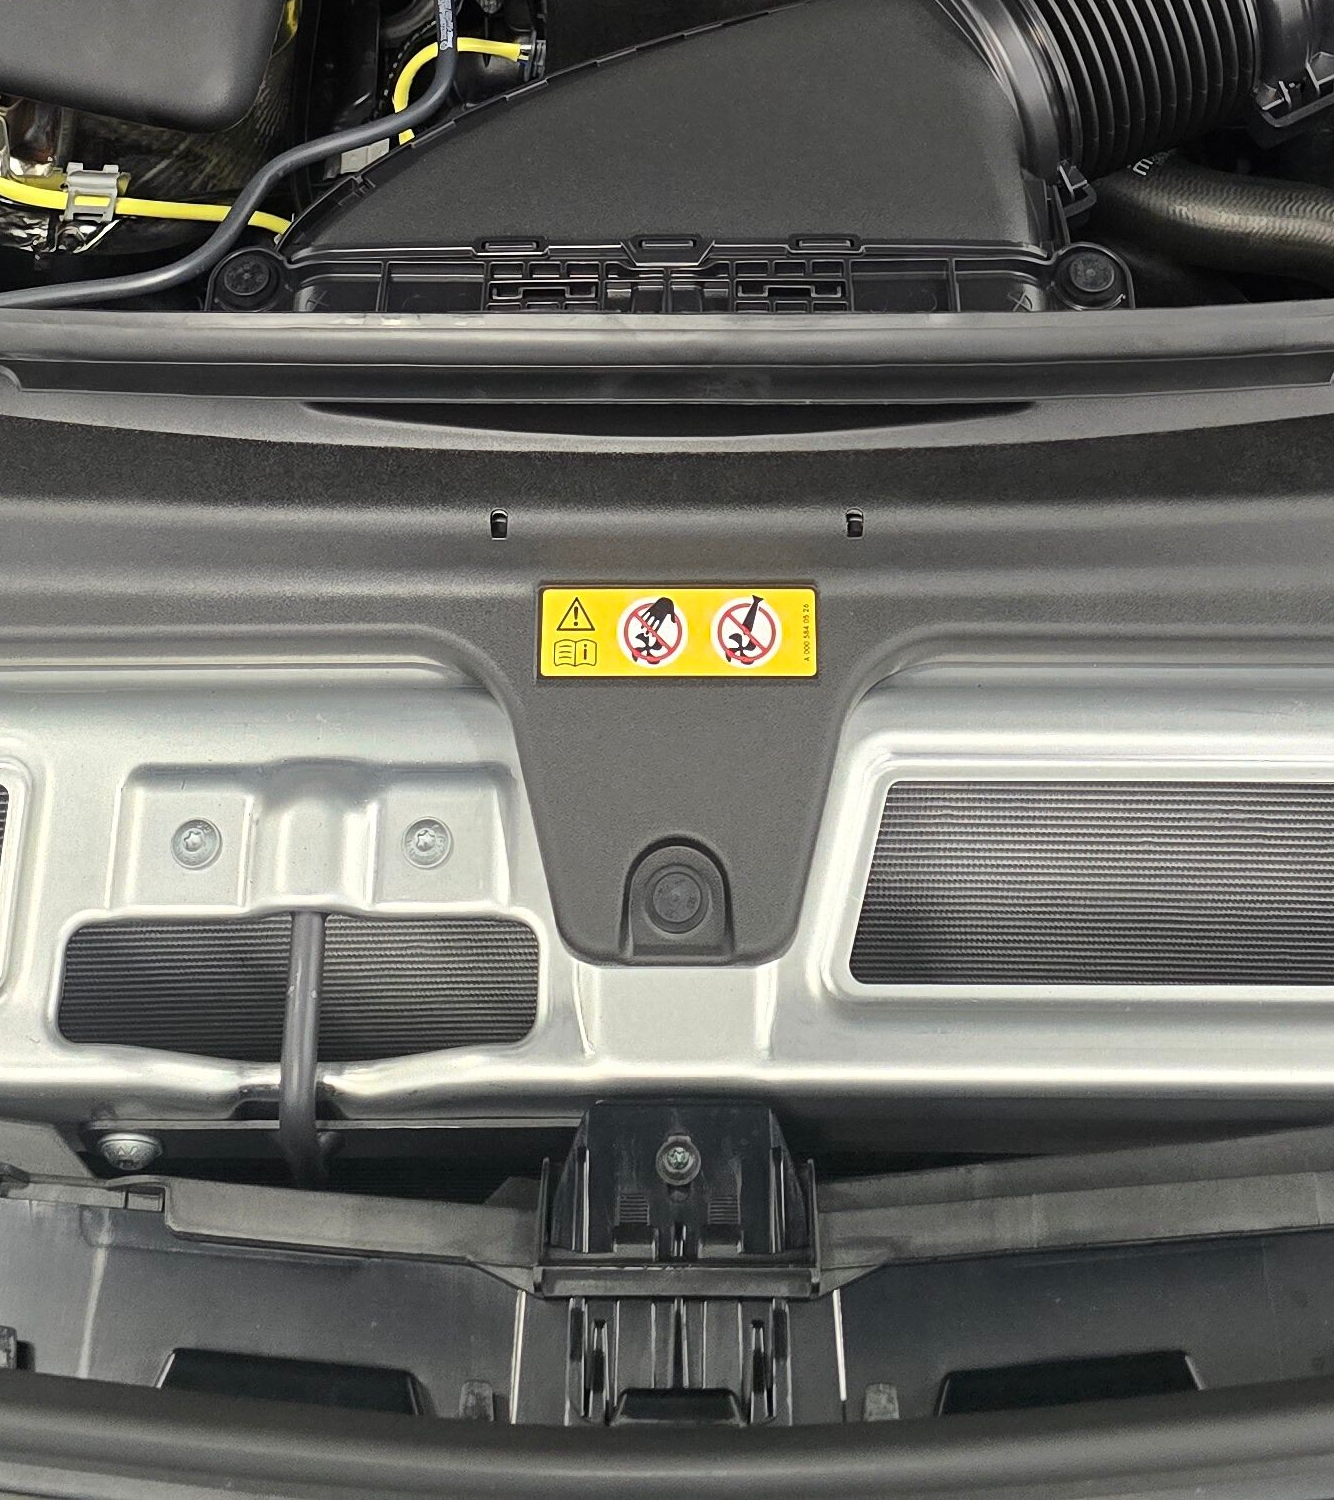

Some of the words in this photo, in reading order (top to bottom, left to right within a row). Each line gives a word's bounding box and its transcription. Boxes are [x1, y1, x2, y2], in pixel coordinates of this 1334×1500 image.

[802, 603, 810, 613] 26
[802, 614, 810, 624] 05
[802, 625, 811, 639] 584
[803, 640, 811, 655] 000
